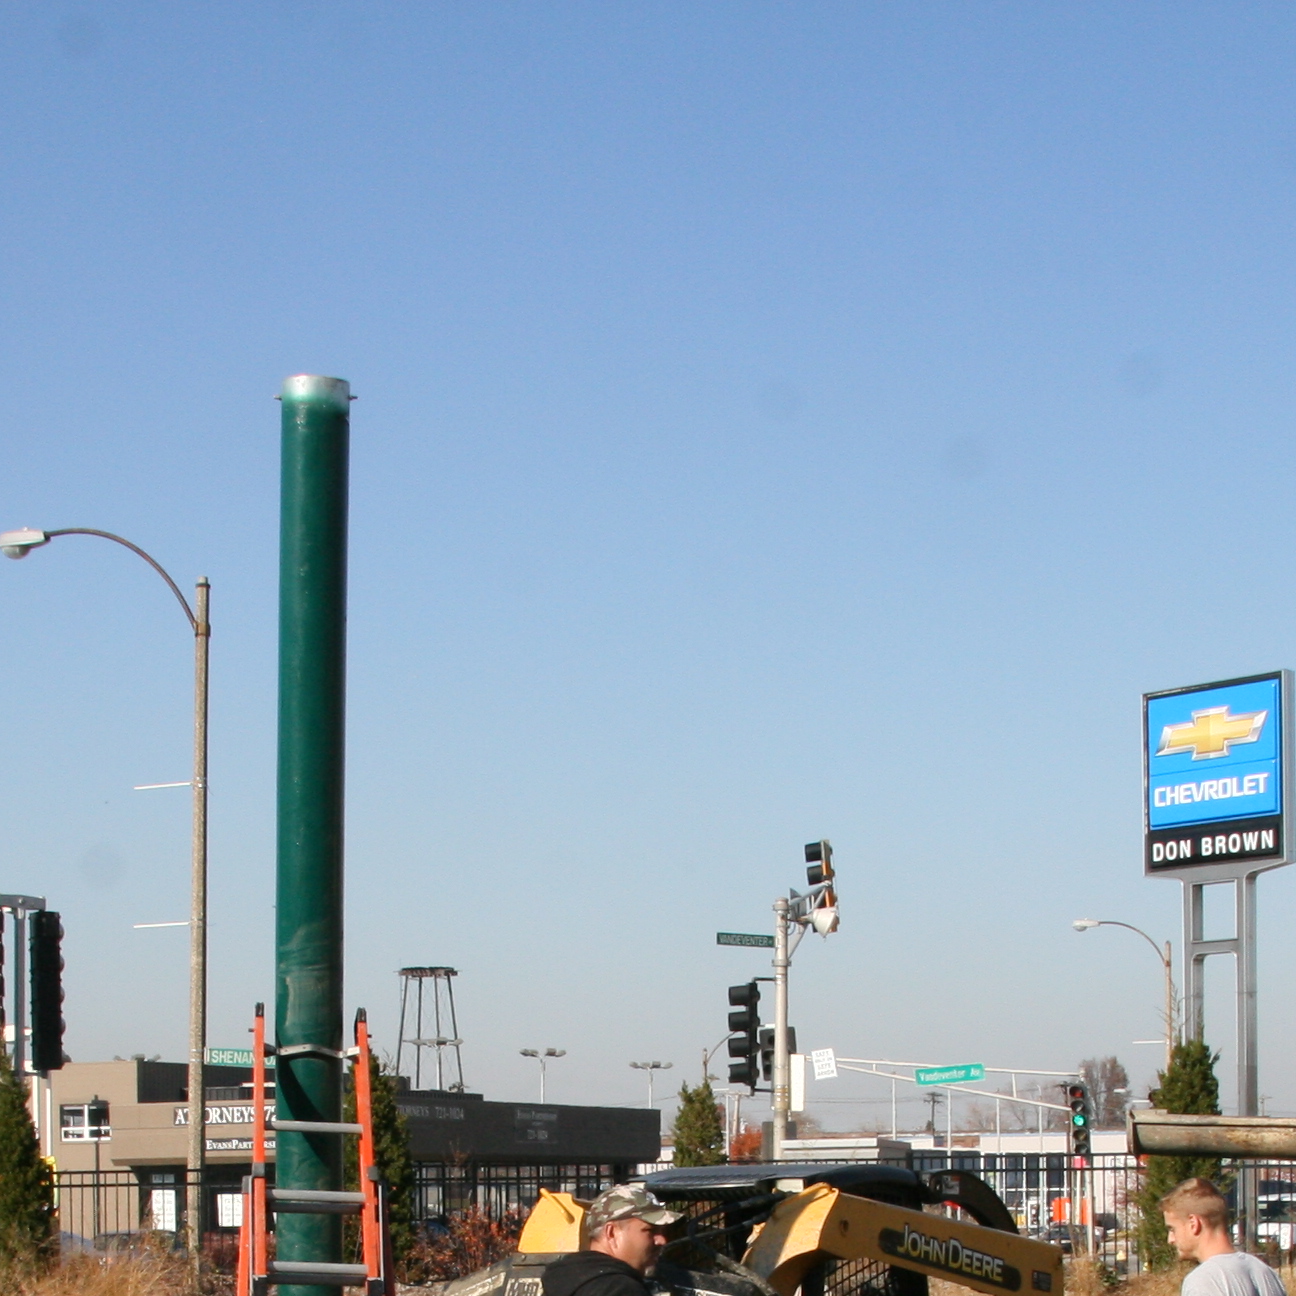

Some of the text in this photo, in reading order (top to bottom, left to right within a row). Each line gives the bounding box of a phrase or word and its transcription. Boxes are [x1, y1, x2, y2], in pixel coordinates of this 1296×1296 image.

[1154, 772, 1269, 808] CHEVROLET
[1152, 829, 1274, 862] DON BROWN
[719, 934, 768, 946] VANDEVENTER
[175, 1105, 254, 1124] ATORNEYS
[896, 1223, 945, 1265] JOHN
[948, 1237, 1004, 1282] DEERE
